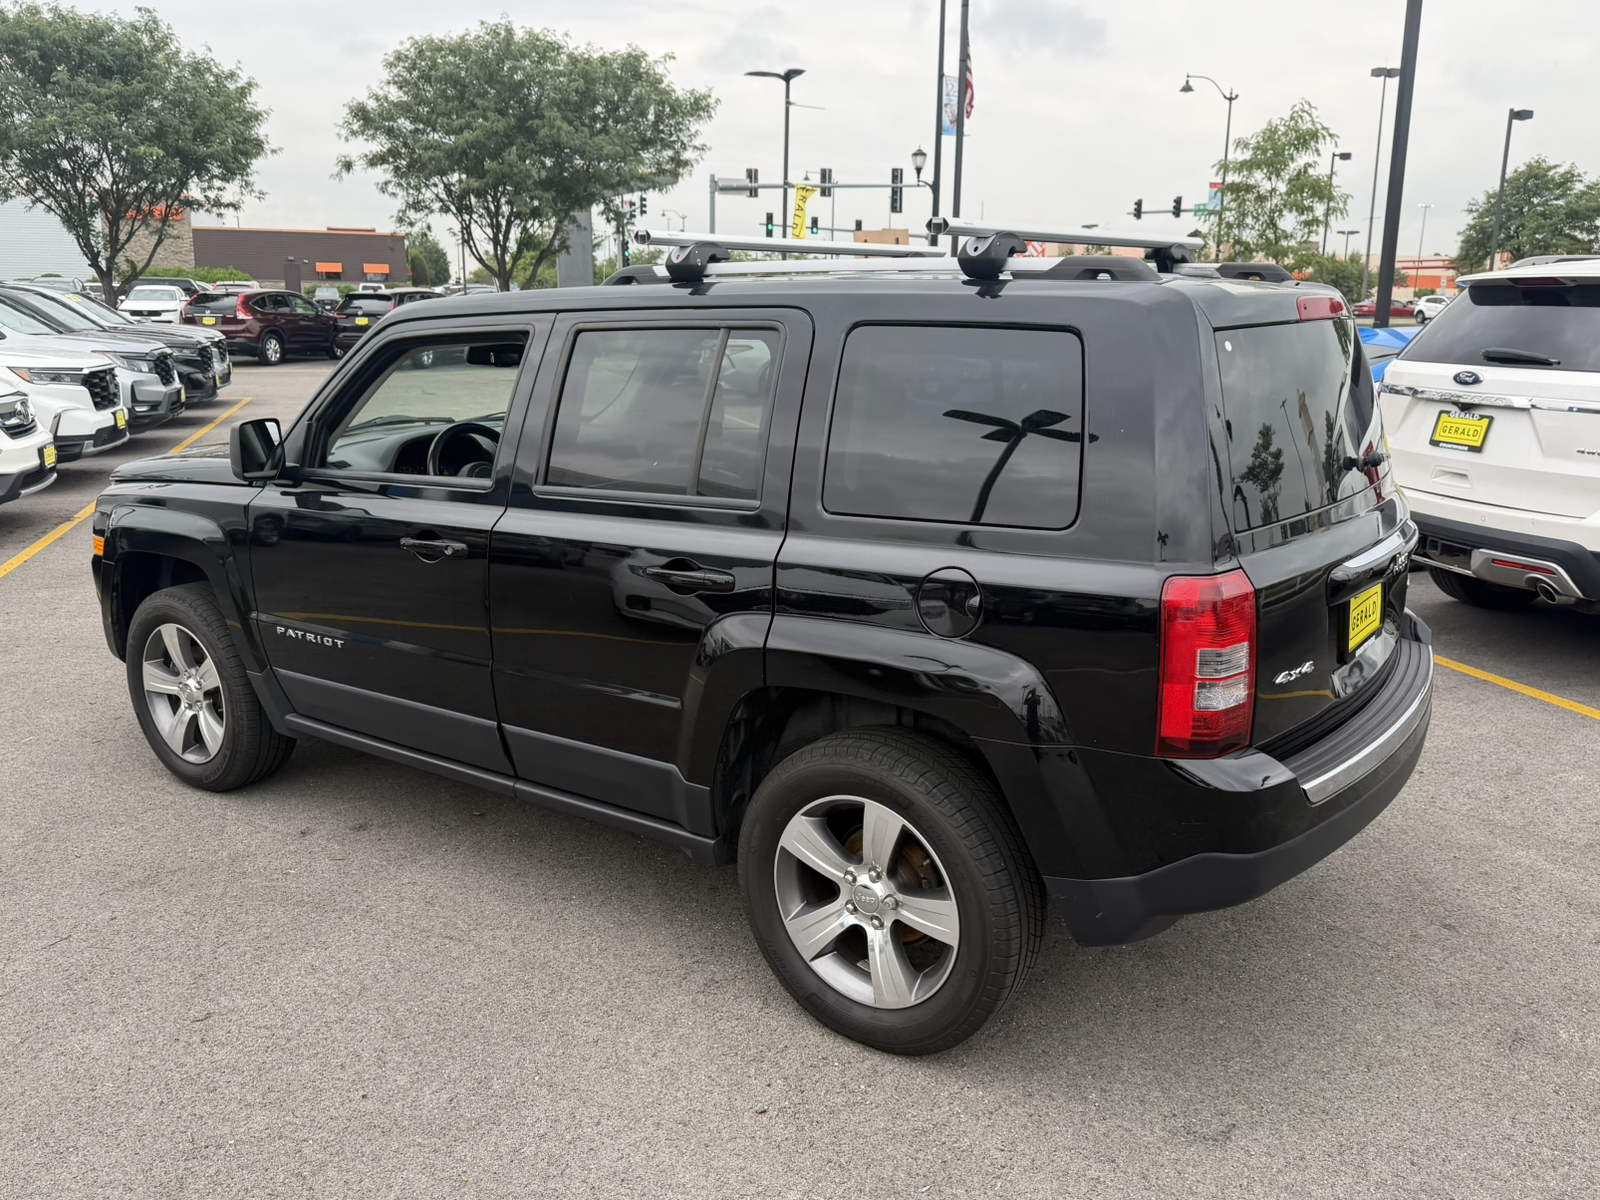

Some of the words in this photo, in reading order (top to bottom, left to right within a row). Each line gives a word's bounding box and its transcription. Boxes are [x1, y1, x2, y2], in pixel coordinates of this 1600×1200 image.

[1456, 372, 1476, 384] Ford
[1449, 410, 1481, 421] GERALD
[1441, 424, 1479, 438] GERALD
[1351, 600, 1377, 632] GERALD
[276, 626, 345, 649] PATRIOT
